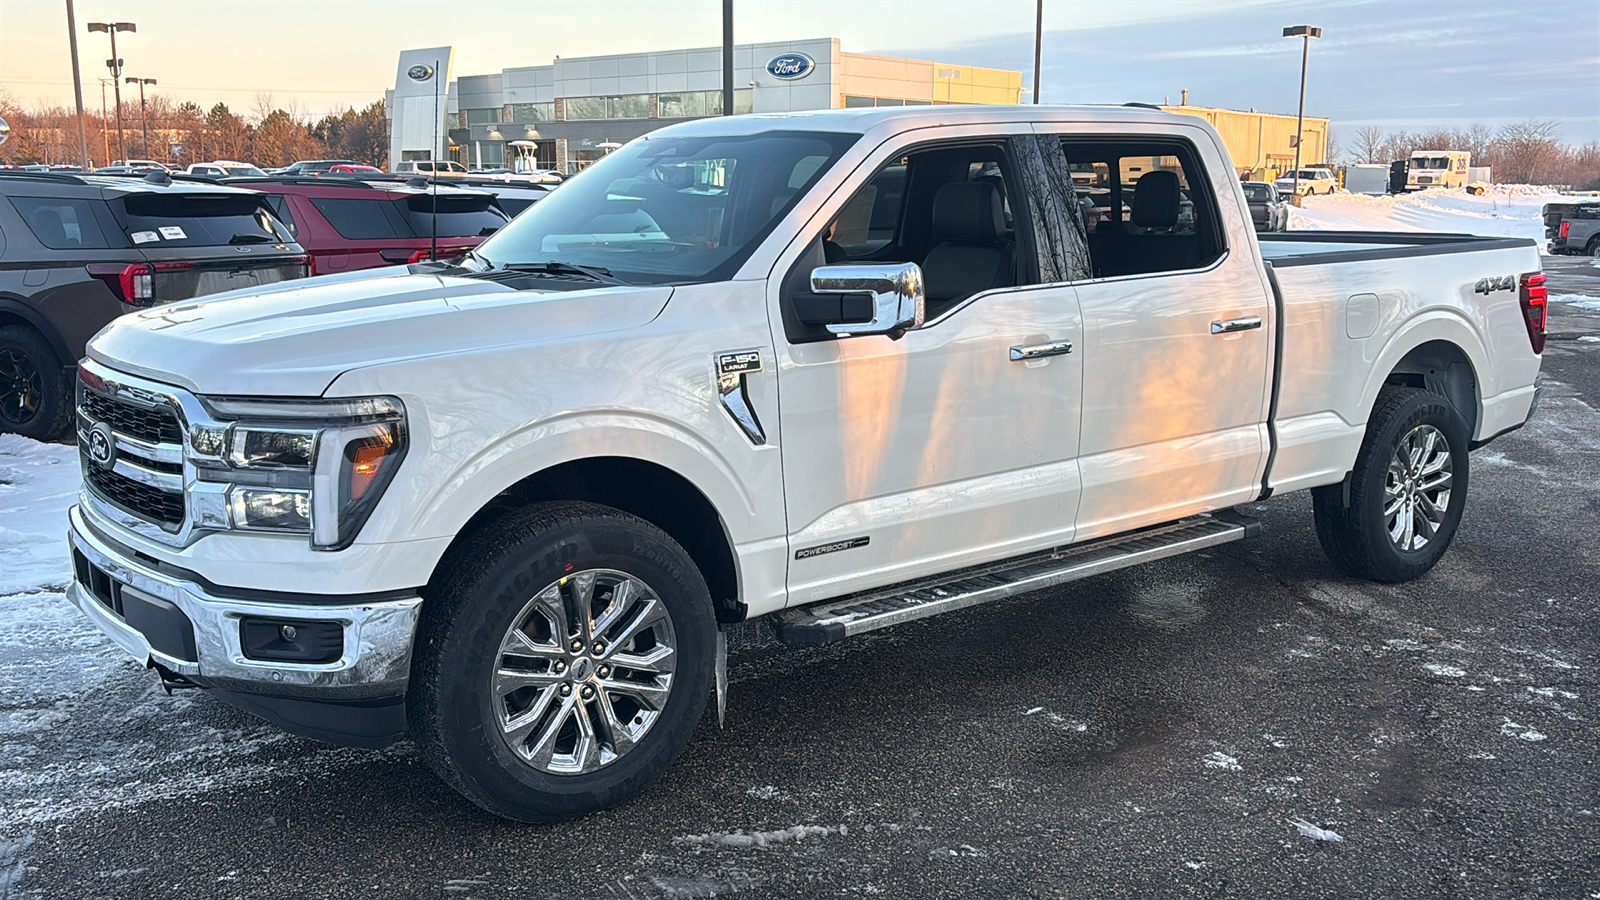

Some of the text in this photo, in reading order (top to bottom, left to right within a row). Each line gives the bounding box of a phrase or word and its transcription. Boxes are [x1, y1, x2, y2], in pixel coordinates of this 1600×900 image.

[774, 58, 801, 74] Ford
[721, 353, 759, 365] F-150
[723, 363, 748, 371] LARIAT
[92, 432, 107, 459] Ford
[797, 541, 853, 558] POWERBOOST
